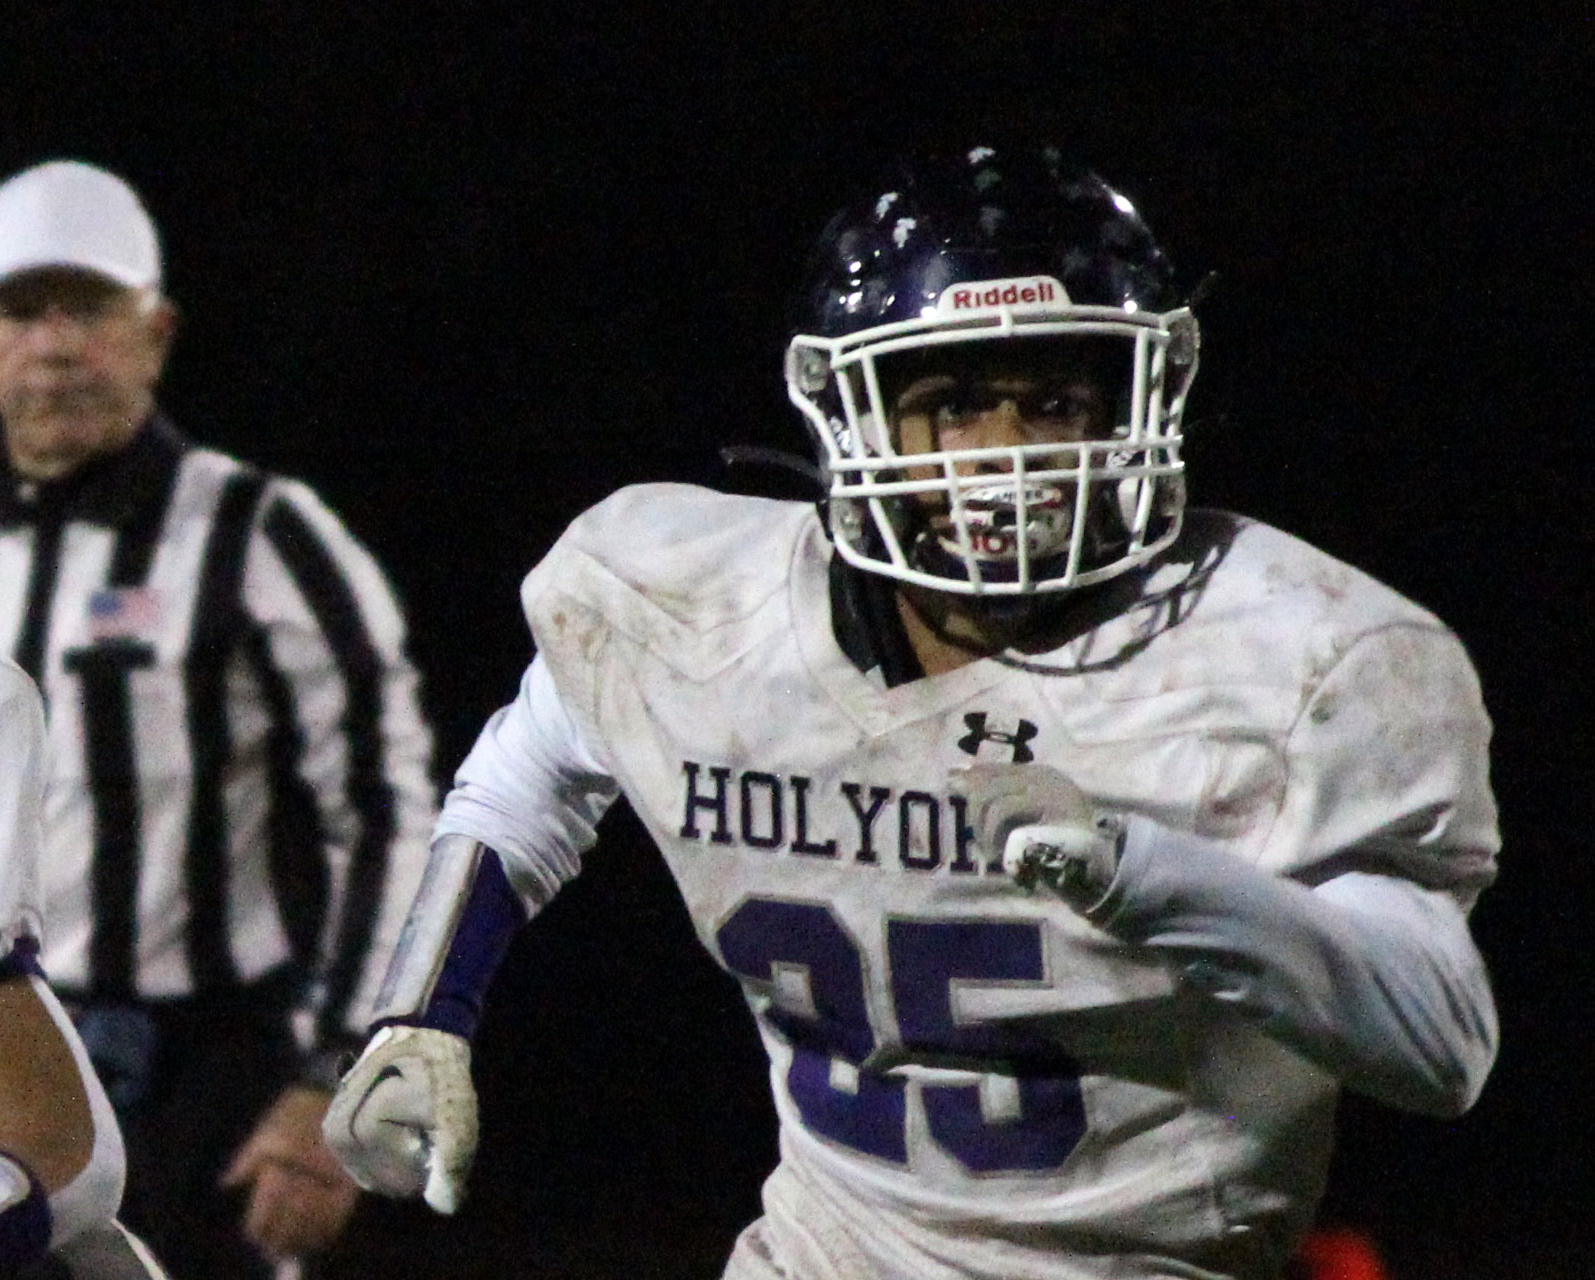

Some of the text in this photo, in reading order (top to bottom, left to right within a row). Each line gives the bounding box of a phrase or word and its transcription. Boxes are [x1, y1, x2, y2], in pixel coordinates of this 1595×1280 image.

[953, 282, 1055, 310] Riddell
[678, 760, 1007, 874] HOLYO
[714, 892, 1093, 1177] 25
